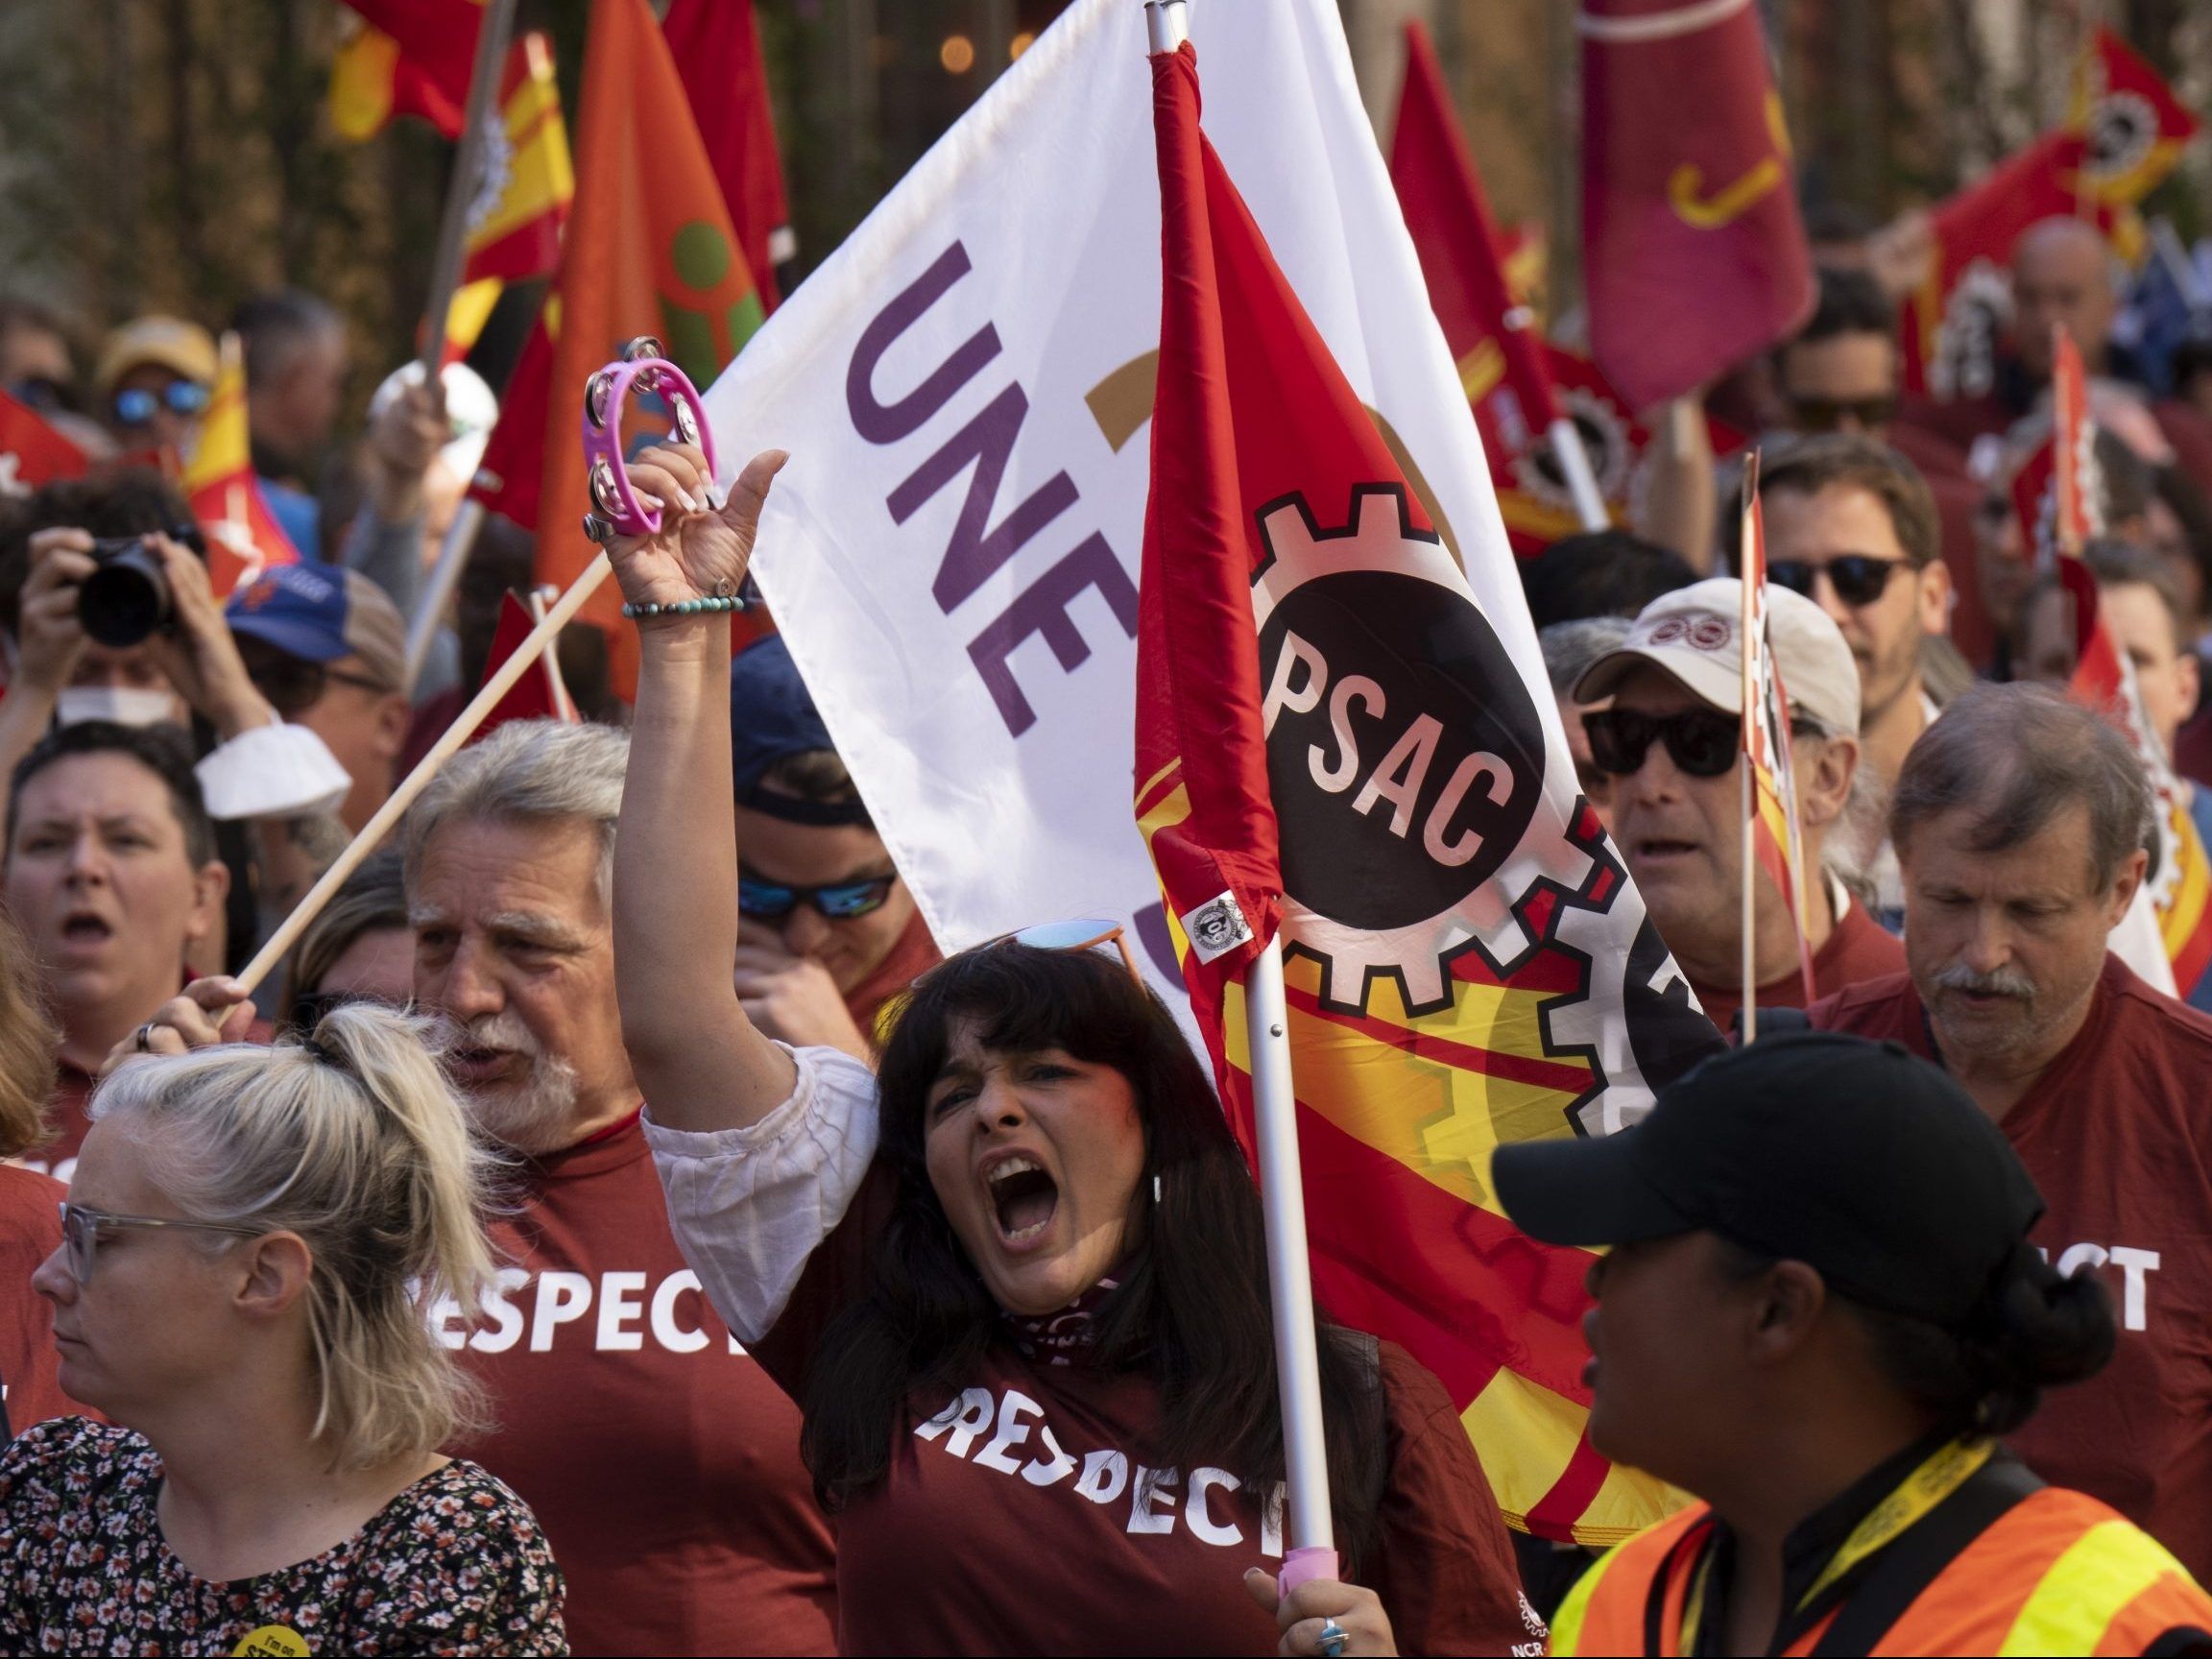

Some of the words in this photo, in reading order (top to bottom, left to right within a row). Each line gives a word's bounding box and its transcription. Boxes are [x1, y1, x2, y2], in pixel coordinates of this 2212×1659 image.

[846, 238, 1140, 739] UNE
[1262, 629, 1514, 866] PSAC
[403, 1268, 747, 1356] ESPEC
